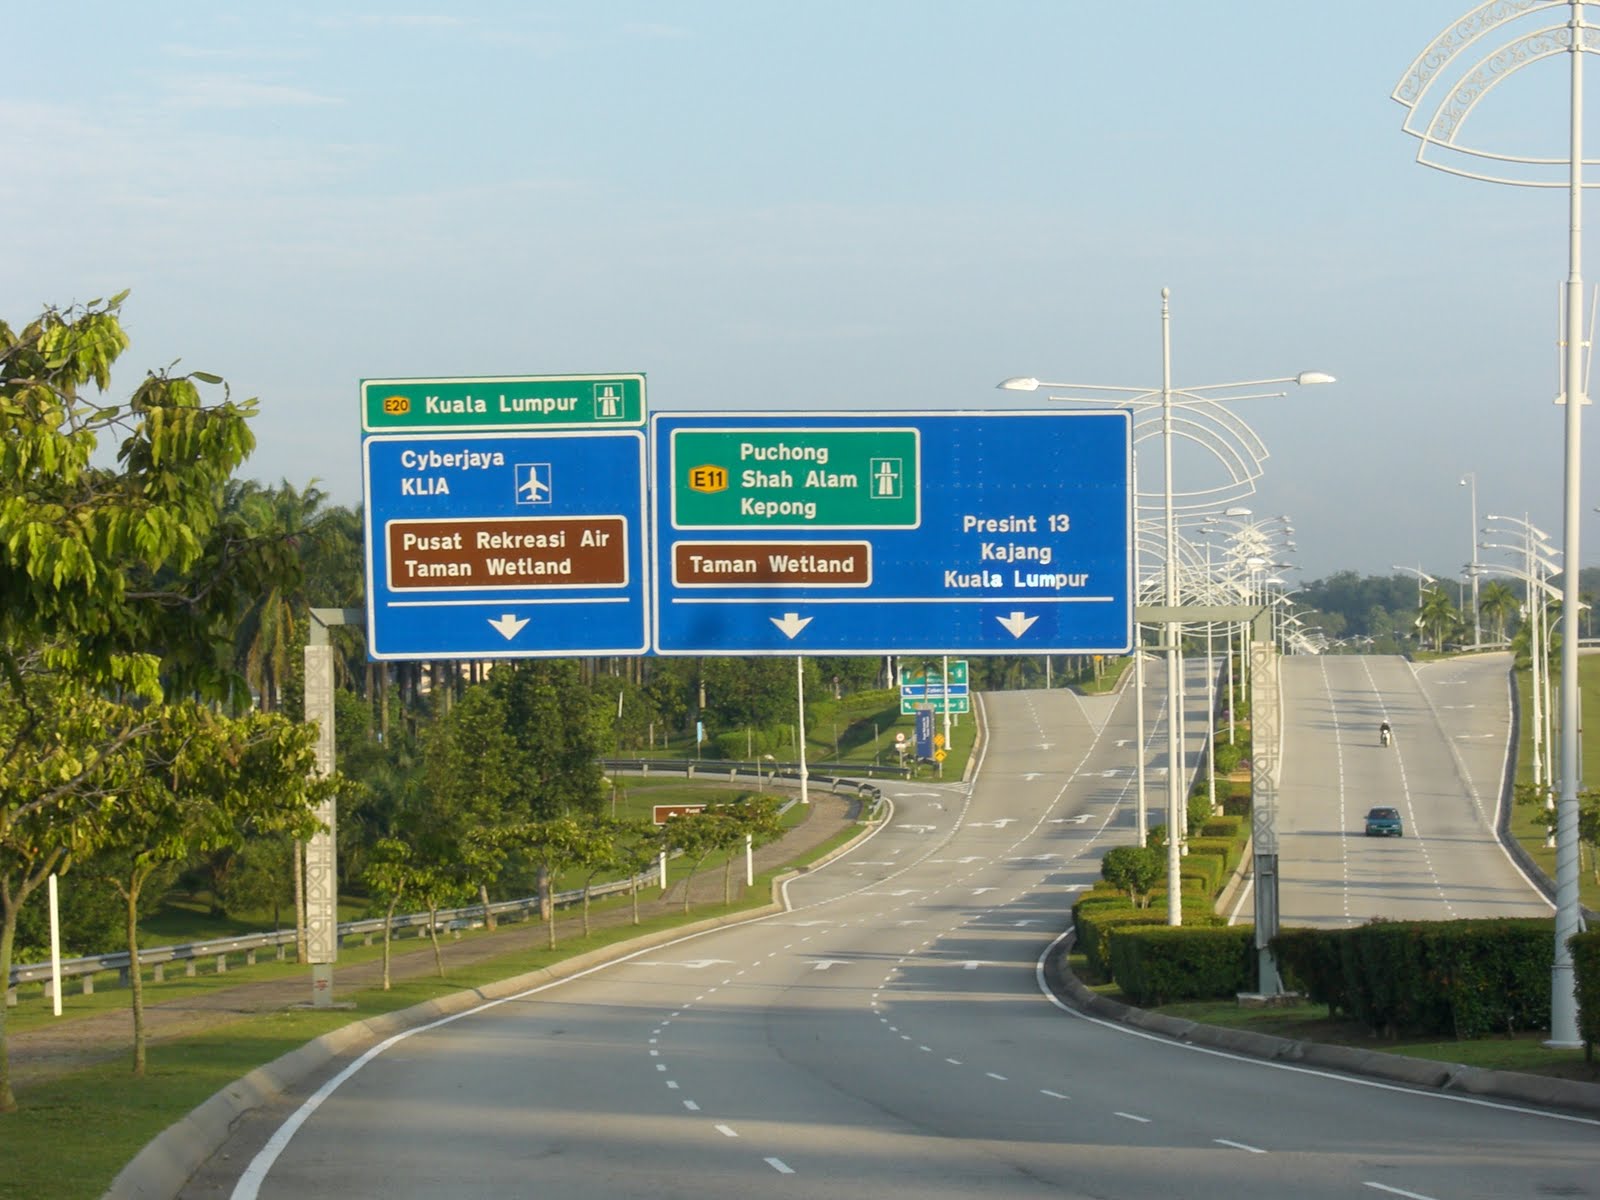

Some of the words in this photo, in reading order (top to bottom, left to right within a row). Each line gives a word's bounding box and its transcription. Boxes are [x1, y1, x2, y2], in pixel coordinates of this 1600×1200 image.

[384, 398, 409, 412] E20
[425, 395, 488, 414] Kuala
[499, 394, 578, 415] Lumpur
[400, 449, 505, 472] Cyberjaya
[740, 442, 829, 465] Puchong
[401, 476, 450, 496] KLIA
[693, 470, 723, 488] E11
[741, 469, 793, 488] Shah
[804, 469, 858, 488] Alam
[740, 497, 817, 520] Kepong
[963, 515, 1037, 533] Presint
[1048, 513, 1070, 533] 13
[403, 532, 463, 551] Pusat
[476, 530, 566, 549] Rekreasi
[580, 529, 610, 548] Air
[689, 555, 757, 573] Taman
[768, 554, 854, 573] Wetland
[981, 542, 1052, 565] Kajang
[404, 559, 472, 578] Taman
[485, 557, 572, 576] Wetland
[944, 569, 1004, 588] Kuala
[1014, 569, 1089, 591] Lumpur
